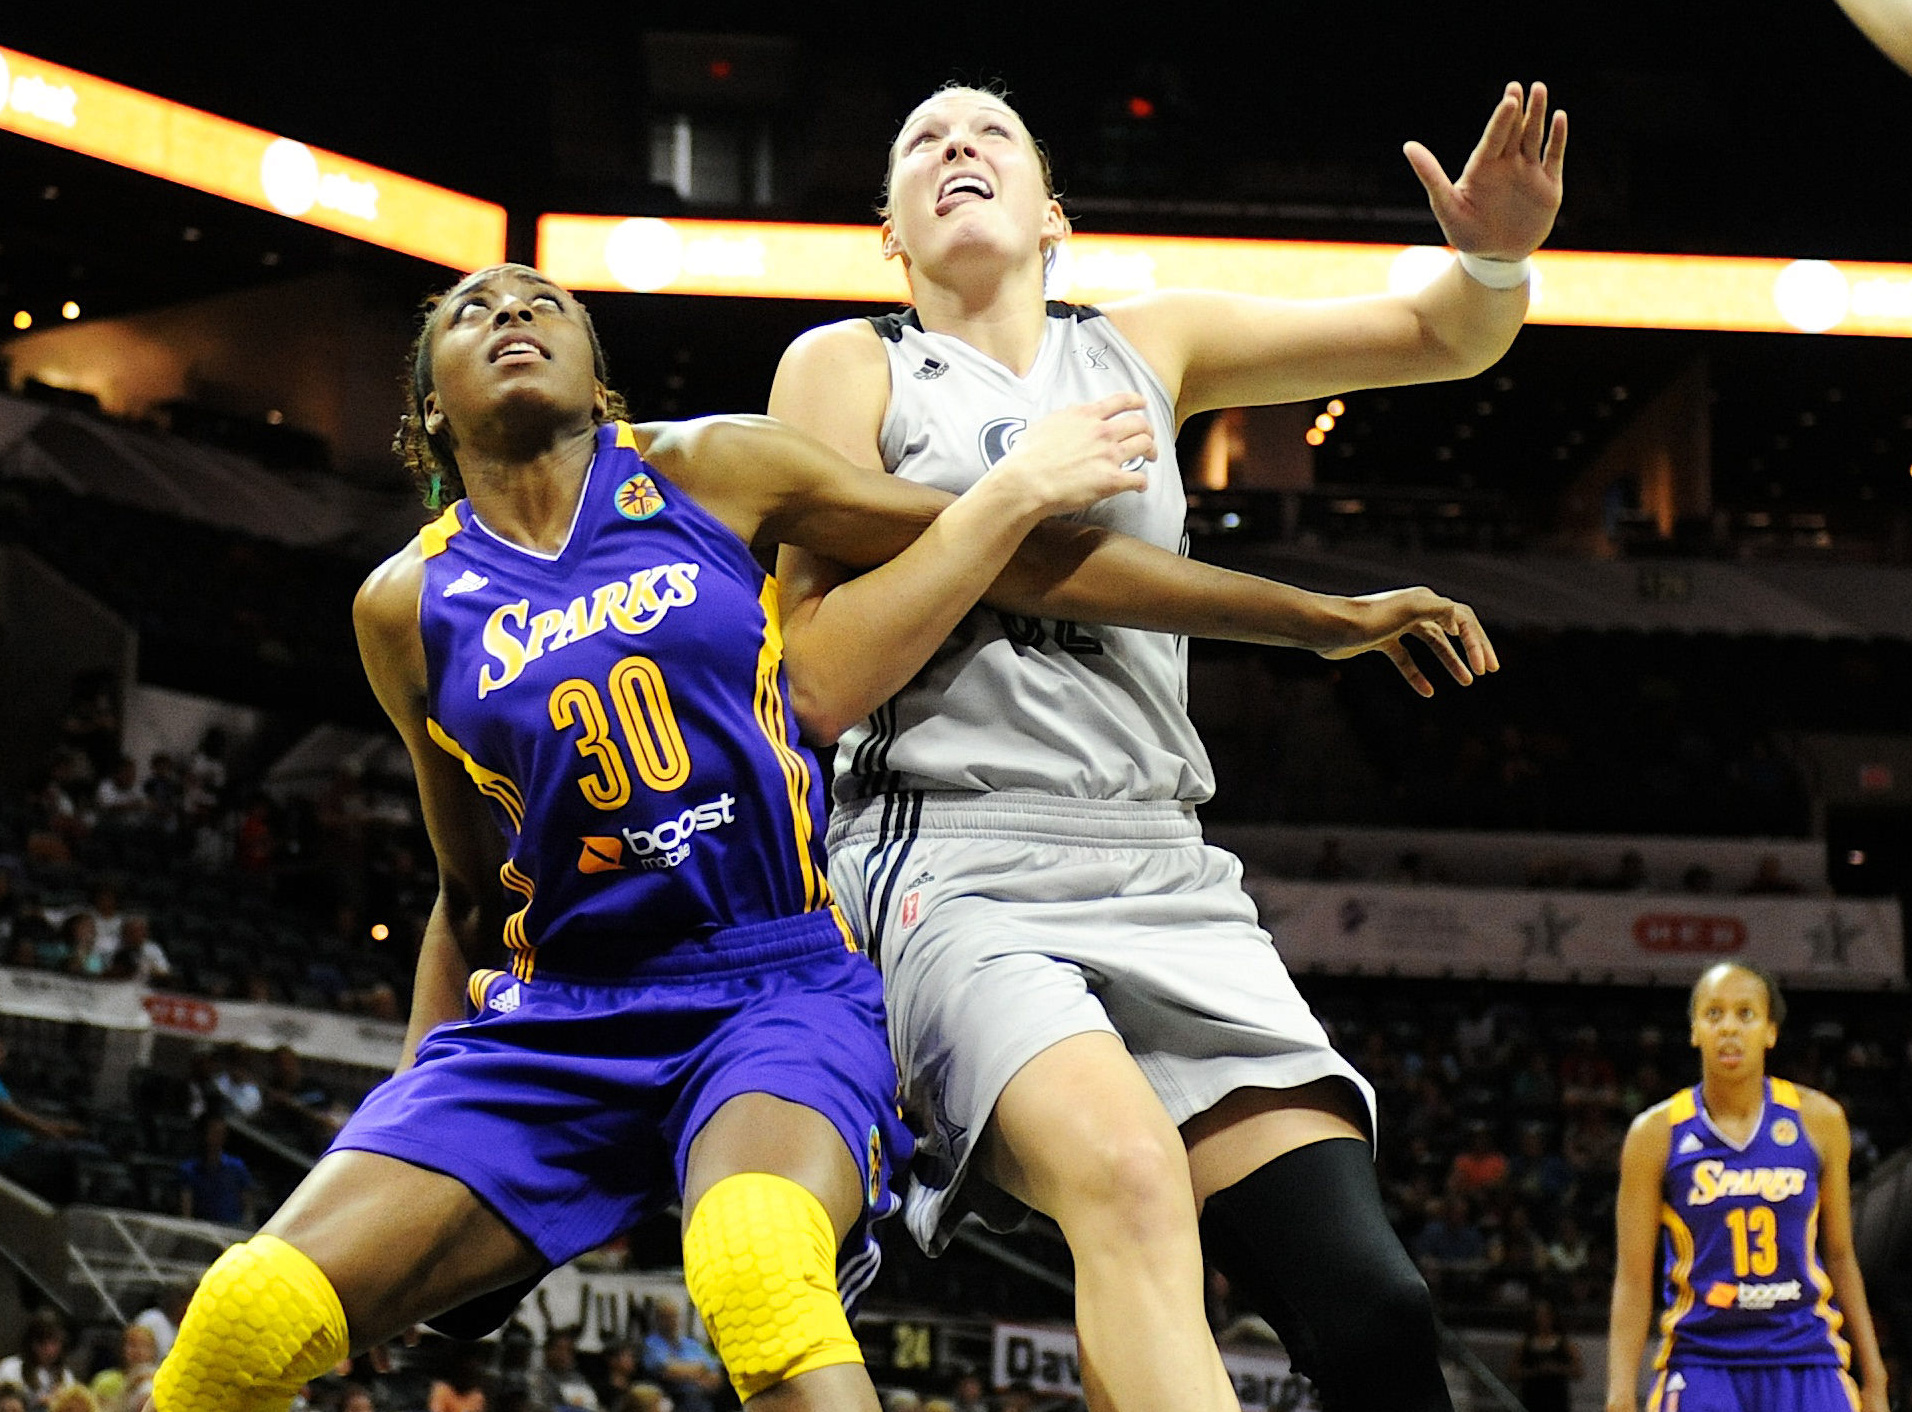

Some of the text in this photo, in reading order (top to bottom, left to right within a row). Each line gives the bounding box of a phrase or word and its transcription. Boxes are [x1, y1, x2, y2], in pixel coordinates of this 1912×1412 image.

[548, 655, 692, 812] 30
[622, 792, 735, 855] boost
[1725, 1205, 1779, 1278] 13
